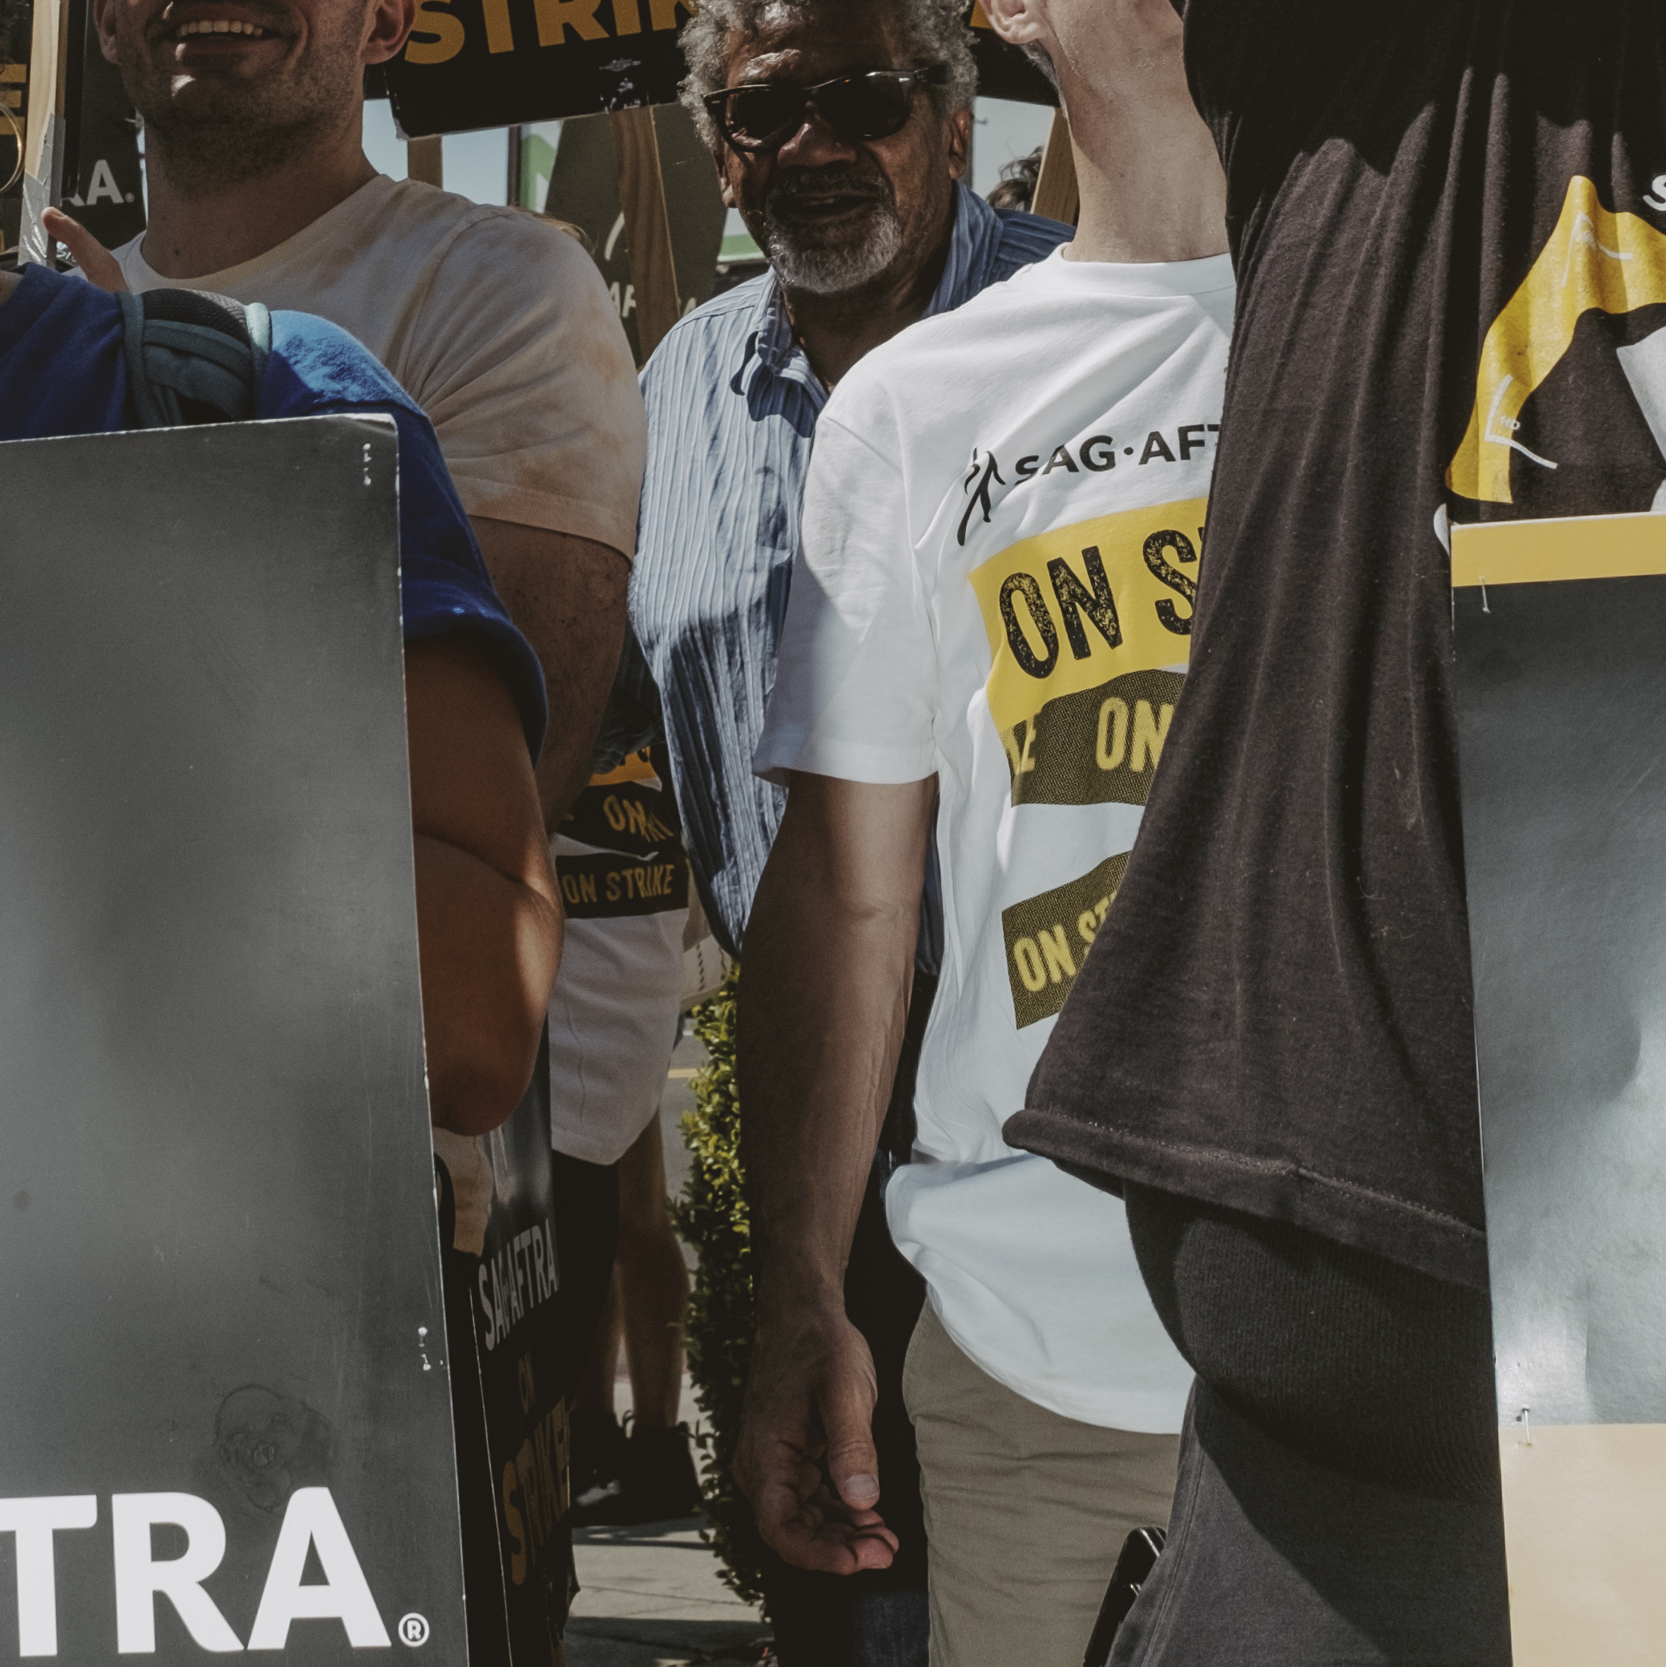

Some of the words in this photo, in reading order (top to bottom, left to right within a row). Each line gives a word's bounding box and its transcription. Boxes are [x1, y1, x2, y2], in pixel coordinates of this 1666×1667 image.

[1014, 423, 1222, 485] SAG·AF
[999, 546, 1123, 679] ON
[562, 872, 598, 904] ON
[605, 864, 676, 902] STRIKE
[1013, 920, 1076, 992] ON
